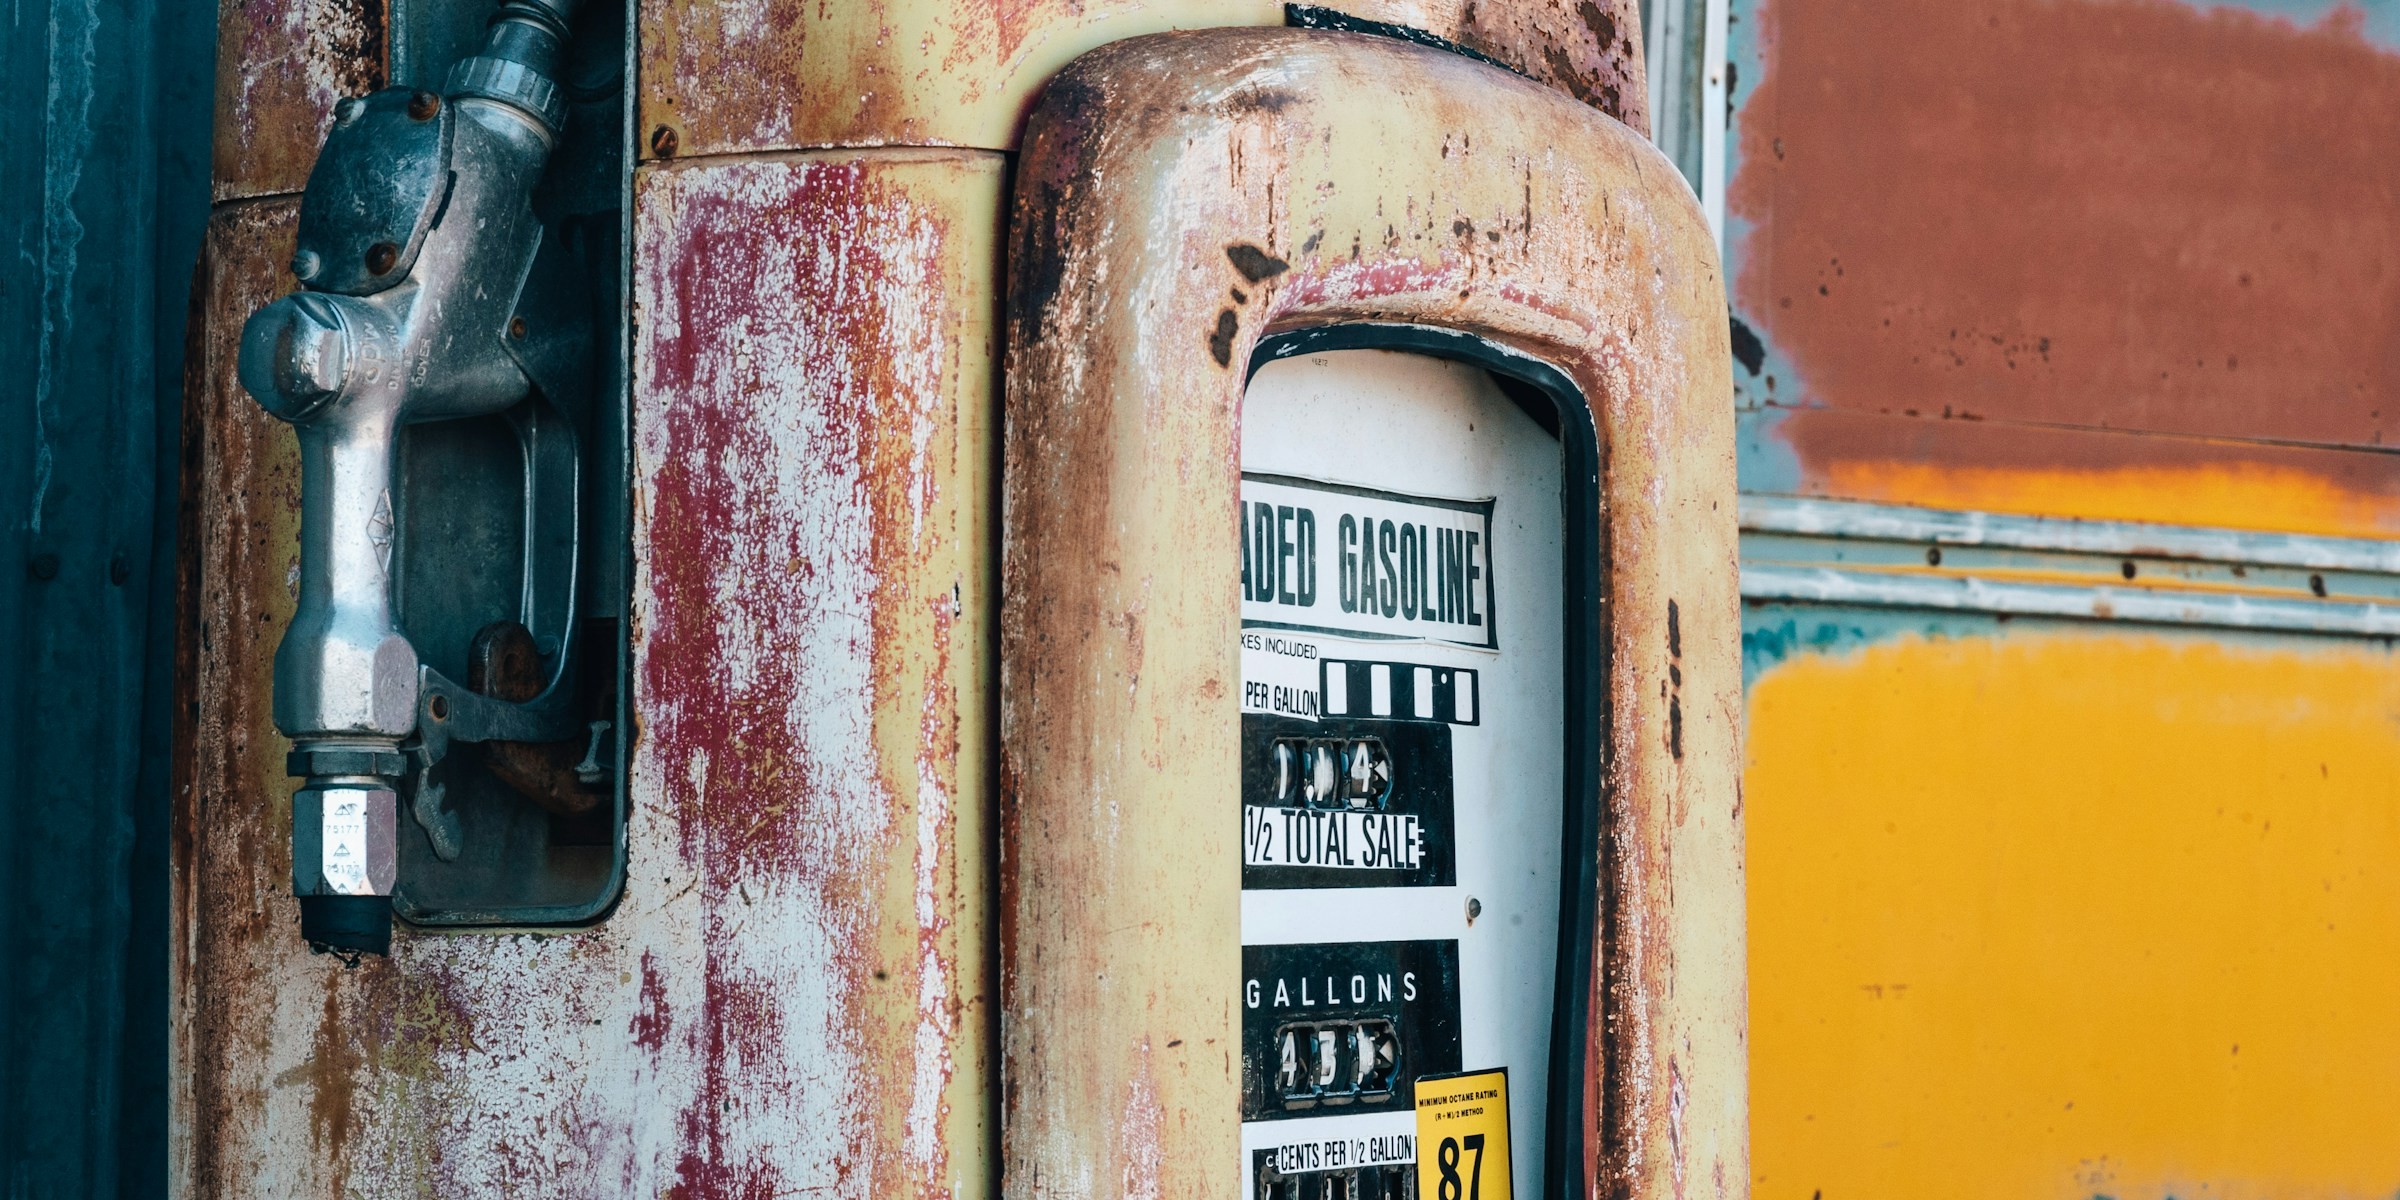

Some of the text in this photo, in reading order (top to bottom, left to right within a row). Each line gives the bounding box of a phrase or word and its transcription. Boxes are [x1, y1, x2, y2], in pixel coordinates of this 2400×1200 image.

[1338, 512, 1482, 627] GASOLINE
[1265, 637, 1317, 660] INCLUDED
[1246, 681, 1268, 709] PER
[1281, 809, 1354, 866] TOTAL
[1362, 814, 1417, 869] SALE
[1246, 972, 1417, 1009] GALLONS
[1419, 1089, 1498, 1107] MINIMUM OCTANE RATING
[1461, 1107, 1484, 1117] METHOD
[1281, 1134, 1412, 1171] CENTS PER 1/2 GALLON
[1438, 1133, 1485, 1200] 87
